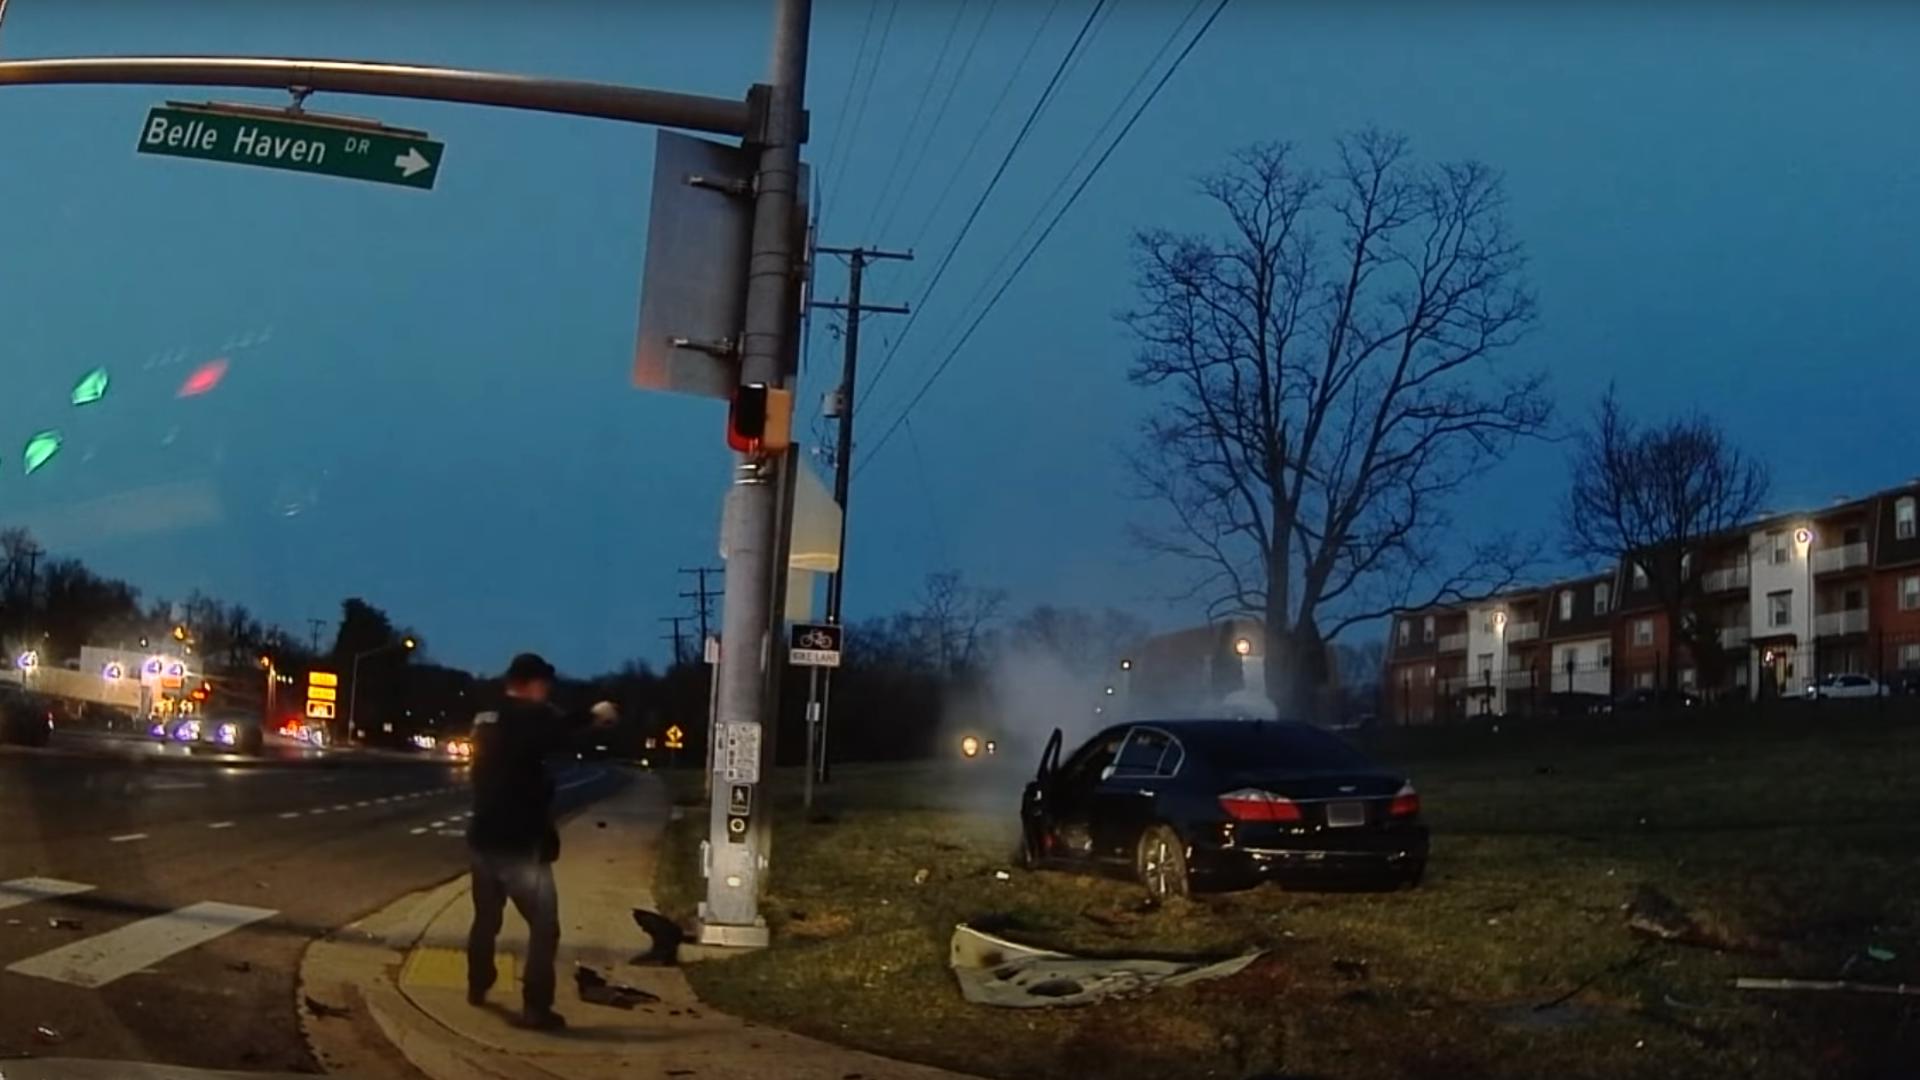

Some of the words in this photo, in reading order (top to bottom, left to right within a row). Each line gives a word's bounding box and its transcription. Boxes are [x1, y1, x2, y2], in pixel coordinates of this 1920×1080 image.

[146, 117, 218, 150] Belle
[233, 126, 326, 164] Haven
[344, 137, 371, 155] DR
[793, 651, 814, 661] BIKE
[816, 652, 837, 664] LANE
